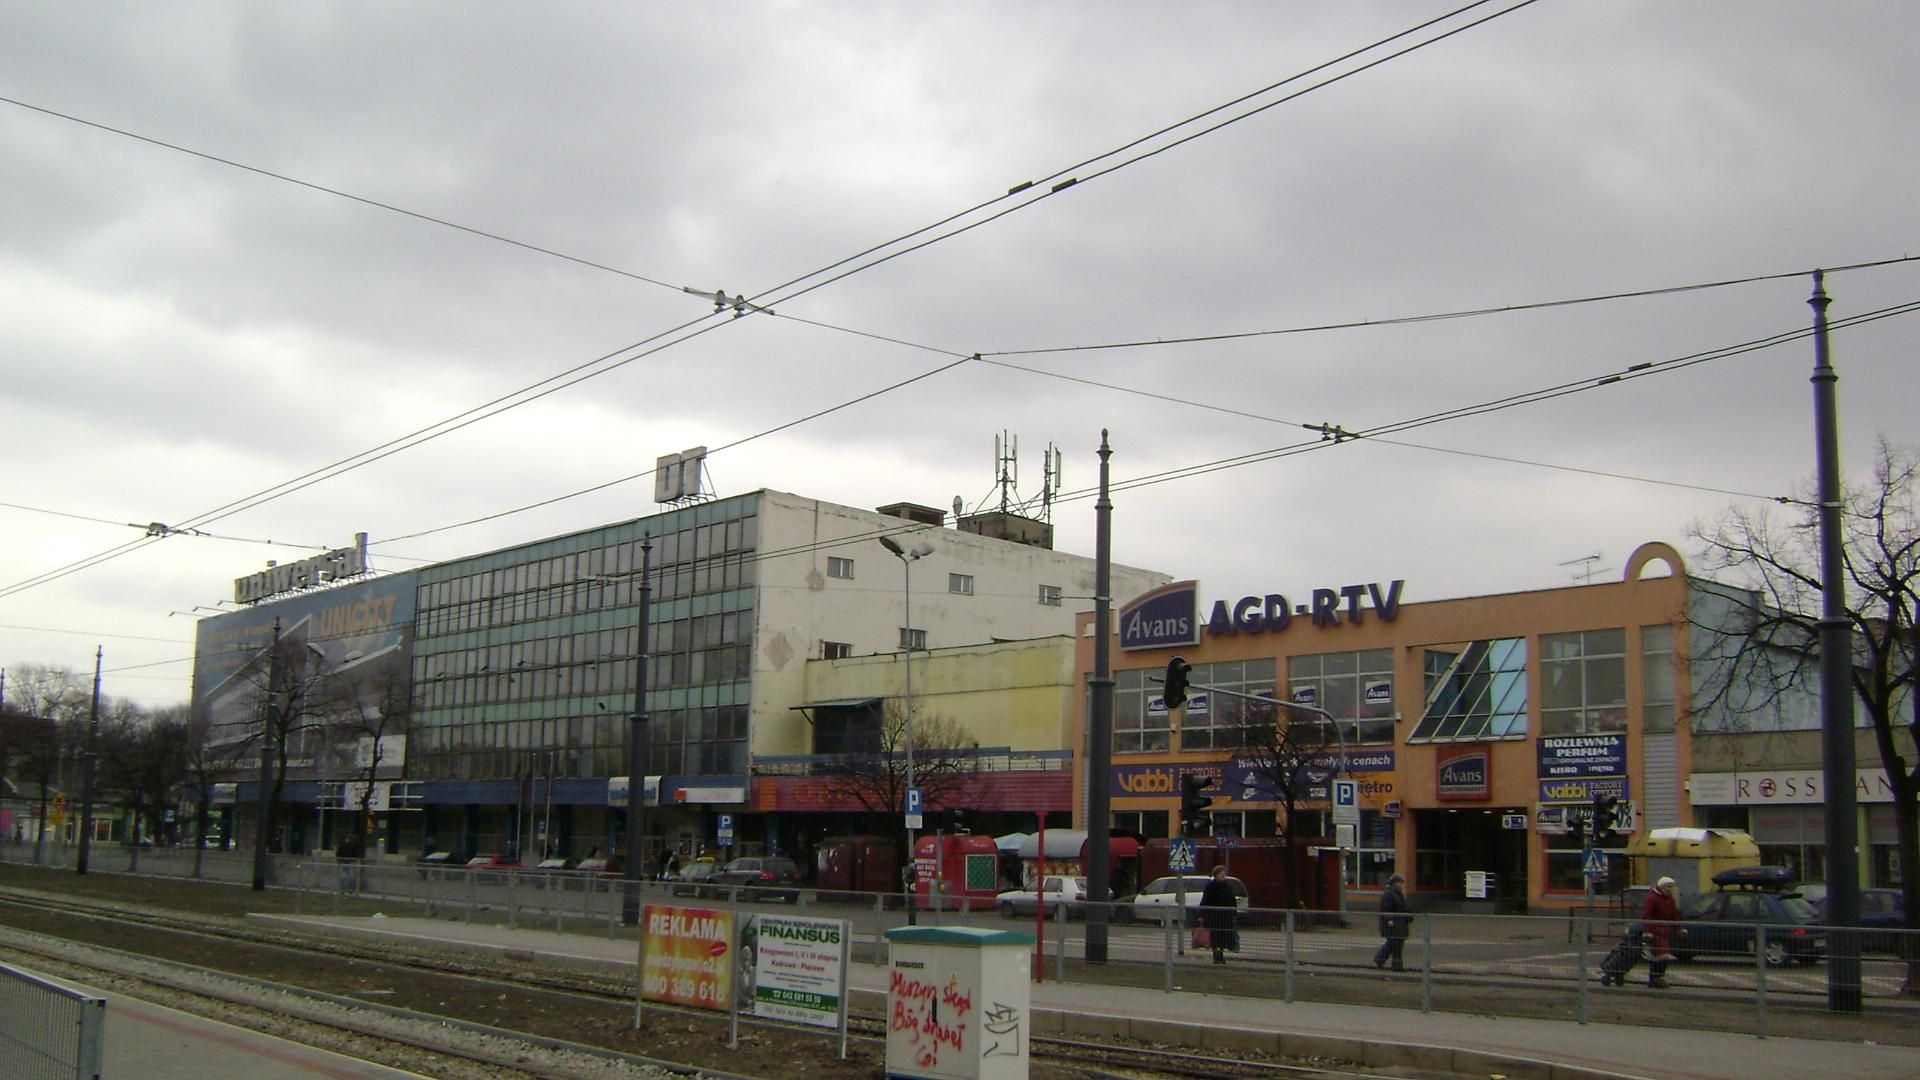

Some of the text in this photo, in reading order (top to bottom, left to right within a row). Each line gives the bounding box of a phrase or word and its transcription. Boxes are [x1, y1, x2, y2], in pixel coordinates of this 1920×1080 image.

[1126, 611, 1189, 640] Avans
[1366, 686, 1390, 698] Avans
[1352, 754, 1391, 766] cenach
[1442, 766, 1482, 783] Avans
[909, 790, 919, 811] P
[1340, 785, 1351, 803] P
[721, 815, 731, 828] P
[649, 914, 725, 940] REKLAMA
[760, 926, 840, 944] FINANSUS
